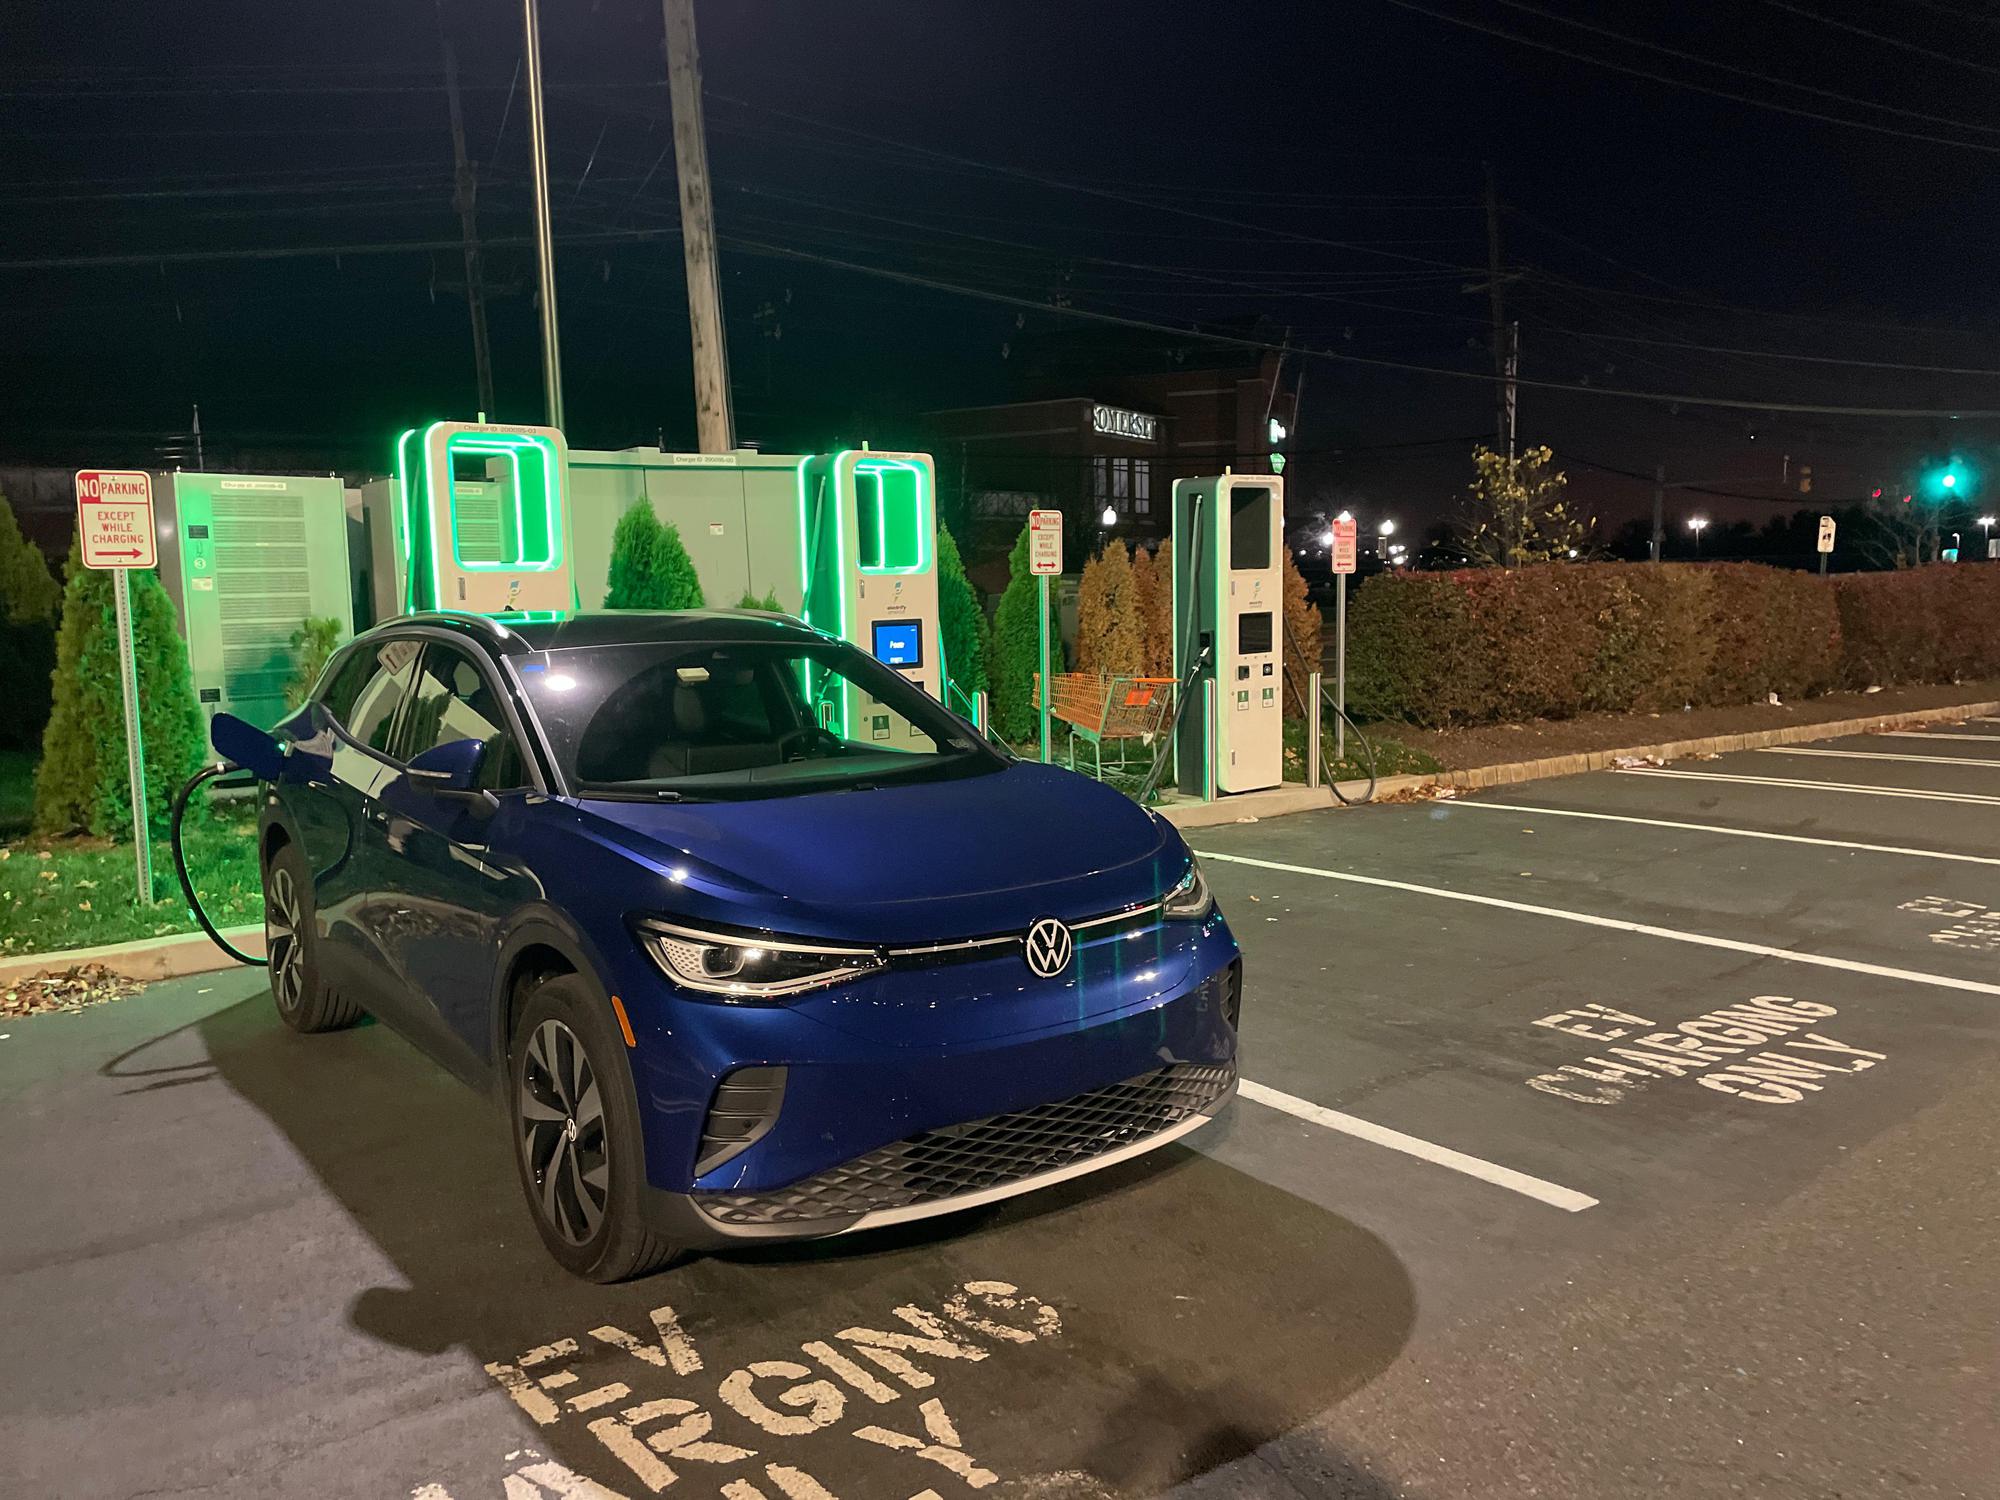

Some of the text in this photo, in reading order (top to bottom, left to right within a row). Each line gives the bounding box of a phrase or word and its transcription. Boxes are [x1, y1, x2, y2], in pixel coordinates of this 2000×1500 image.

[1093, 406, 1156, 439] SOMERSET
[80, 479, 145, 498] NO PARKING
[98, 511, 135, 521] EXCEPT
[102, 523, 132, 532] WHILE
[93, 535, 143, 544] CHARGING
[1531, 1003, 1656, 1042] EV
[1525, 995, 1838, 1105] CHARGING
[1696, 1032, 1888, 1104] ONLY
[484, 1306, 703, 1425] EV
